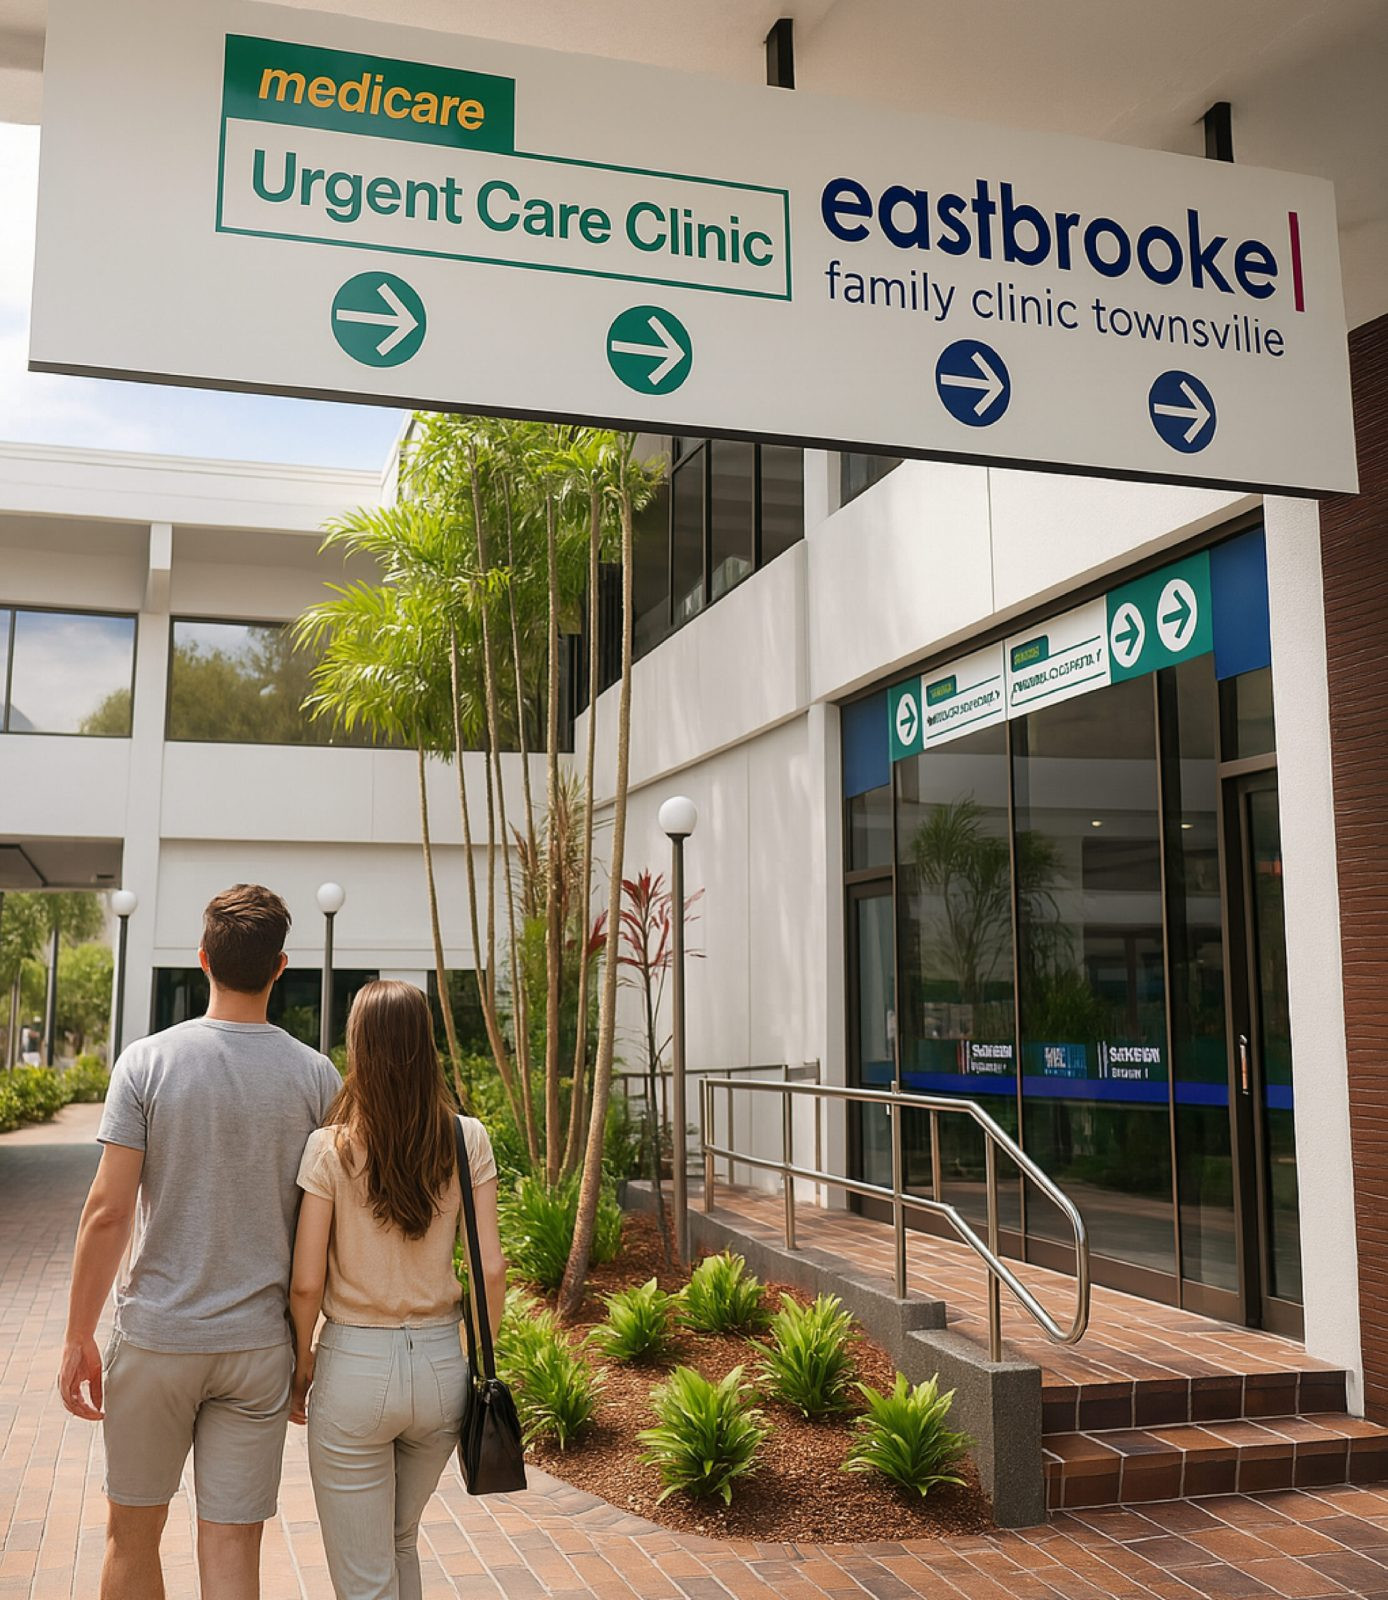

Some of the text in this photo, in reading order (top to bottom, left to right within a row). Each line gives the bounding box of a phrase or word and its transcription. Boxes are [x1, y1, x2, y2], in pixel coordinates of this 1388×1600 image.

[258, 66, 486, 131] medicare
[251, 148, 774, 267] Urgent Care Clinic
[821, 177, 1279, 299] eastbrooke
[824, 260, 956, 321] family
[971, 282, 1079, 330] clinic
